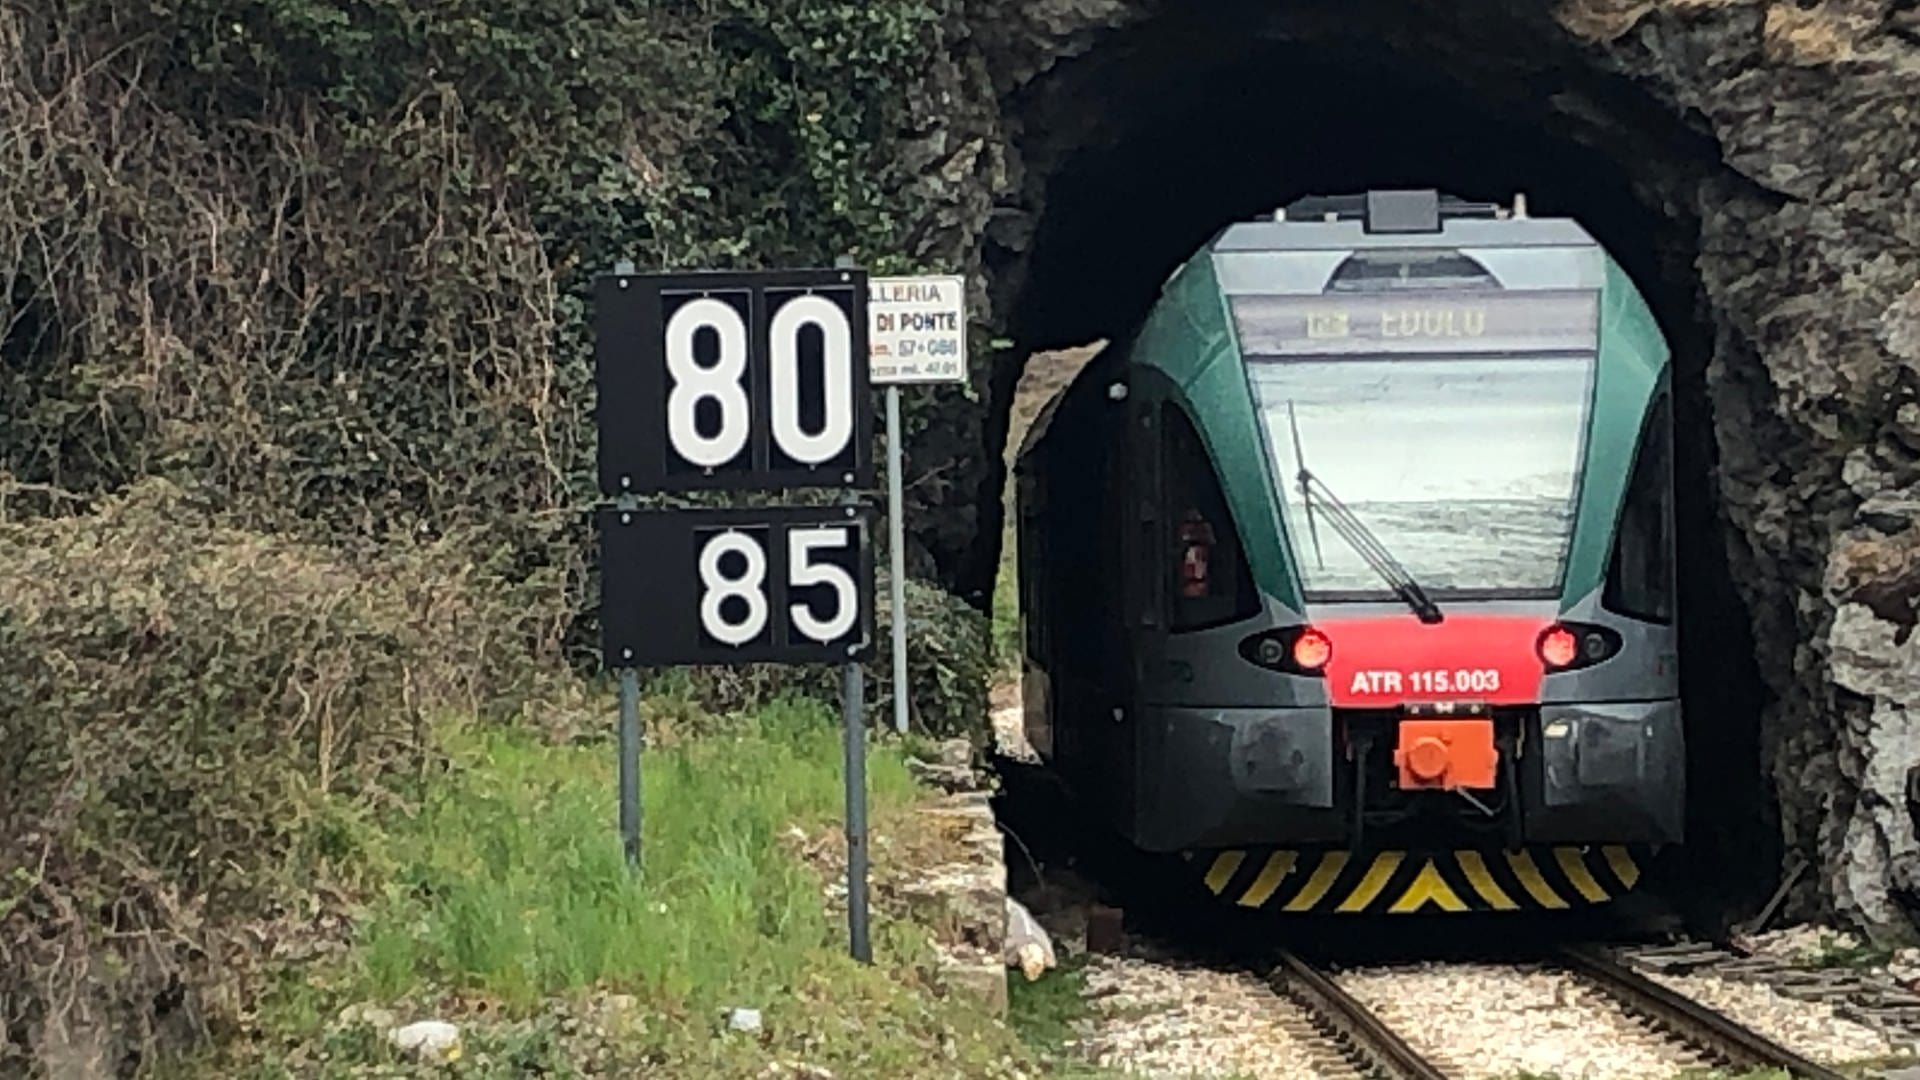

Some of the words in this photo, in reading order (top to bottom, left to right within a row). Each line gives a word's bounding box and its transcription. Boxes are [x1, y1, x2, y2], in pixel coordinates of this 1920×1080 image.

[876, 312, 895, 332] DI
[901, 311, 957, 331] PONTE
[664, 294, 855, 467] 80
[698, 528, 858, 644] 85
[1350, 671, 1403, 694] ATR
[1408, 669, 1500, 693] 115.003
